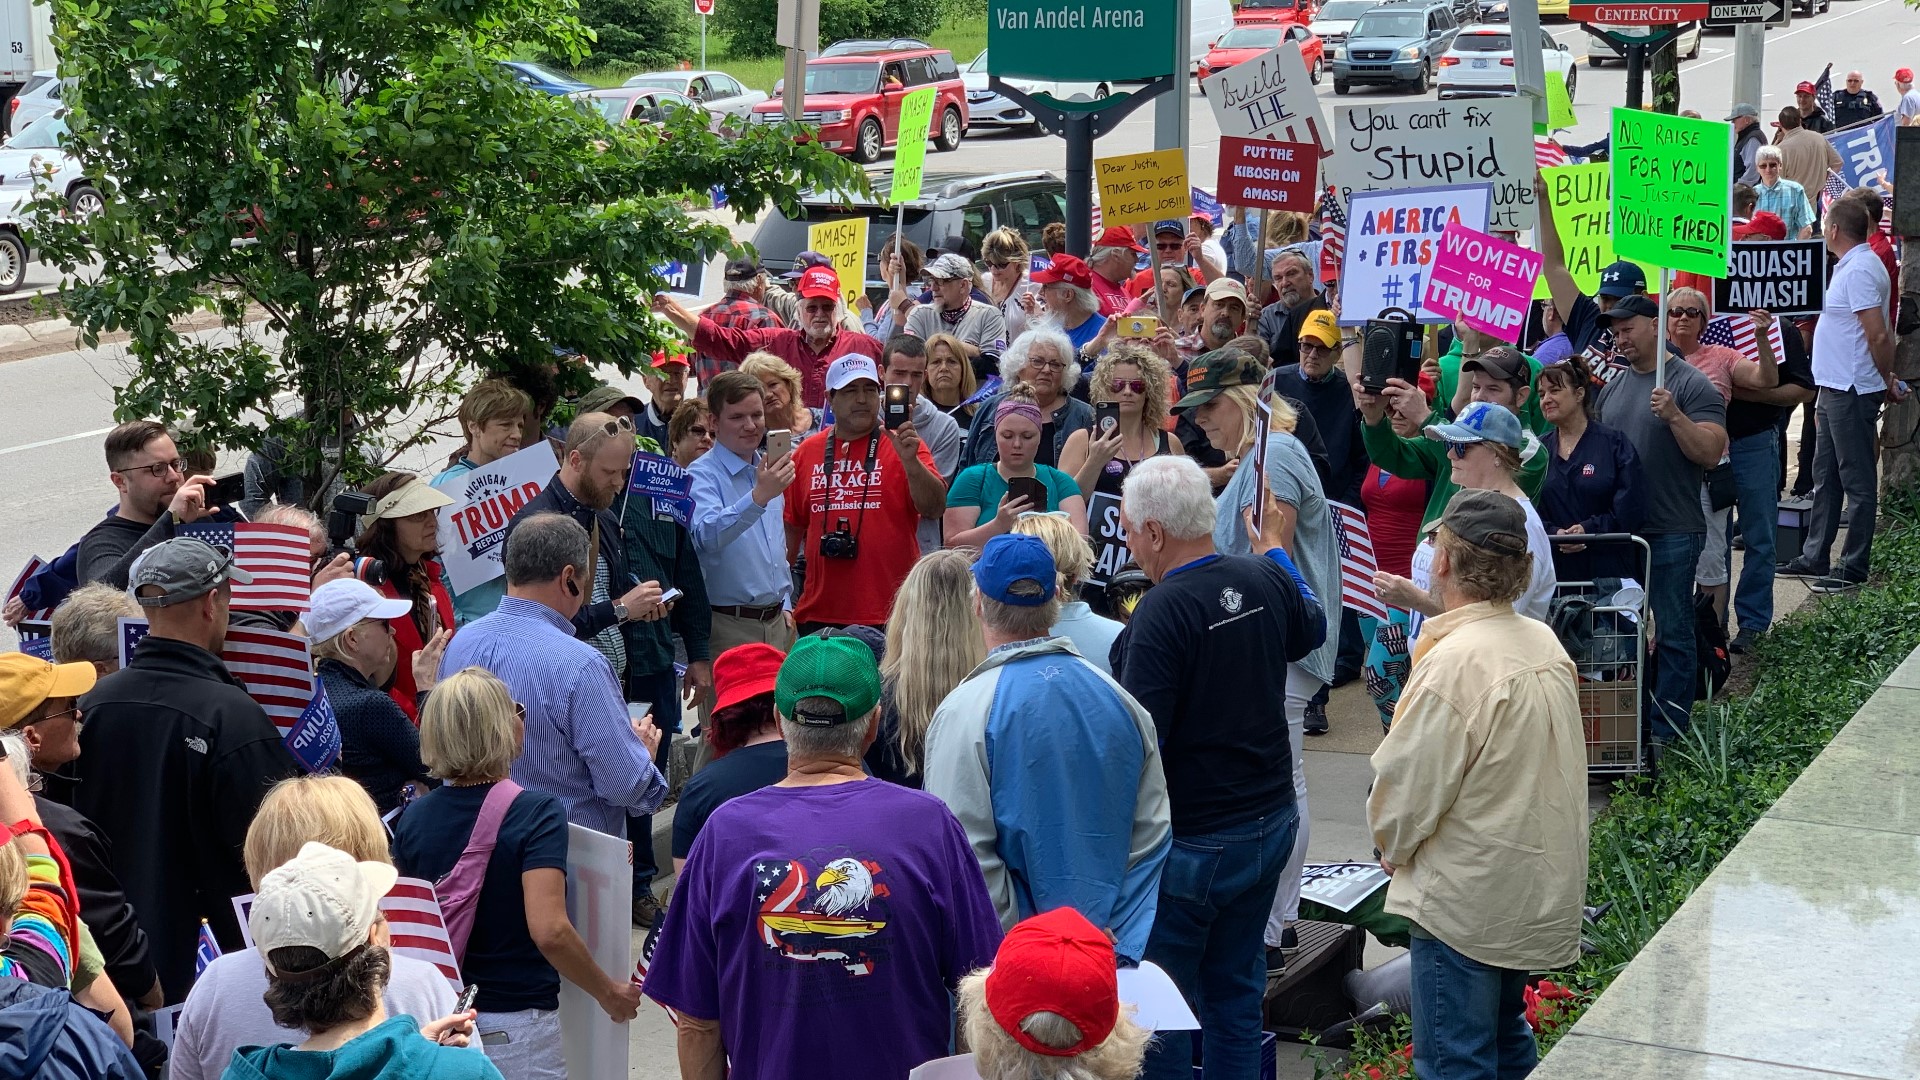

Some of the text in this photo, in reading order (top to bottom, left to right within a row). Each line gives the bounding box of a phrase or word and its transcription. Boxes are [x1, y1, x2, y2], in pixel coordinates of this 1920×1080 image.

[996, 5, 1145, 29] Van Andel Arena
[1714, 4, 1764, 17] ONE WAY
[11, 41, 23, 54] 53
[1221, 54, 1286, 109] build
[1245, 93, 1294, 130] THE
[1348, 107, 1400, 152] You
[1409, 107, 1451, 130] can't
[1463, 106, 1493, 128] fix
[1619, 120, 1700, 147] NO RAISE
[1102, 158, 1160, 175] Dear Justin,
[1243, 145, 1294, 162] PUT THE
[1367, 136, 1507, 183] Stupid
[1847, 129, 1888, 194] TRU
[1233, 165, 1300, 183] KIBOSH ON
[1630, 155, 1707, 185] FOR YOU
[1104, 175, 1183, 195] TIME TO GET
[1243, 186, 1288, 203] AMASH
[1556, 171, 1611, 207] BUI
[1640, 183, 1696, 204] JUSTIN
[1108, 206, 1116, 216] A
[1120, 202, 1151, 216] REAL
[1155, 196, 1185, 211] JOB!!!
[814, 224, 857, 252] AMASH
[1619, 205, 1725, 259] YOU'RE FIRED!
[1375, 239, 1441, 267] FIRS
[1446, 231, 1538, 283] WOMEN
[1727, 249, 1812, 279] SQUASH
[1382, 273, 1422, 309] #1
[1467, 272, 1492, 291] FOR
[1728, 280, 1808, 308] AMASH
[1430, 278, 1523, 330] TRUMP
[638, 458, 689, 480] TRUMP
[811, 459, 883, 476] MCHAL
[464, 474, 507, 500] MICHIGAN
[834, 488, 854, 501] 2ND
[450, 481, 543, 545] TRUMP
[475, 529, 507, 551] REPUB
